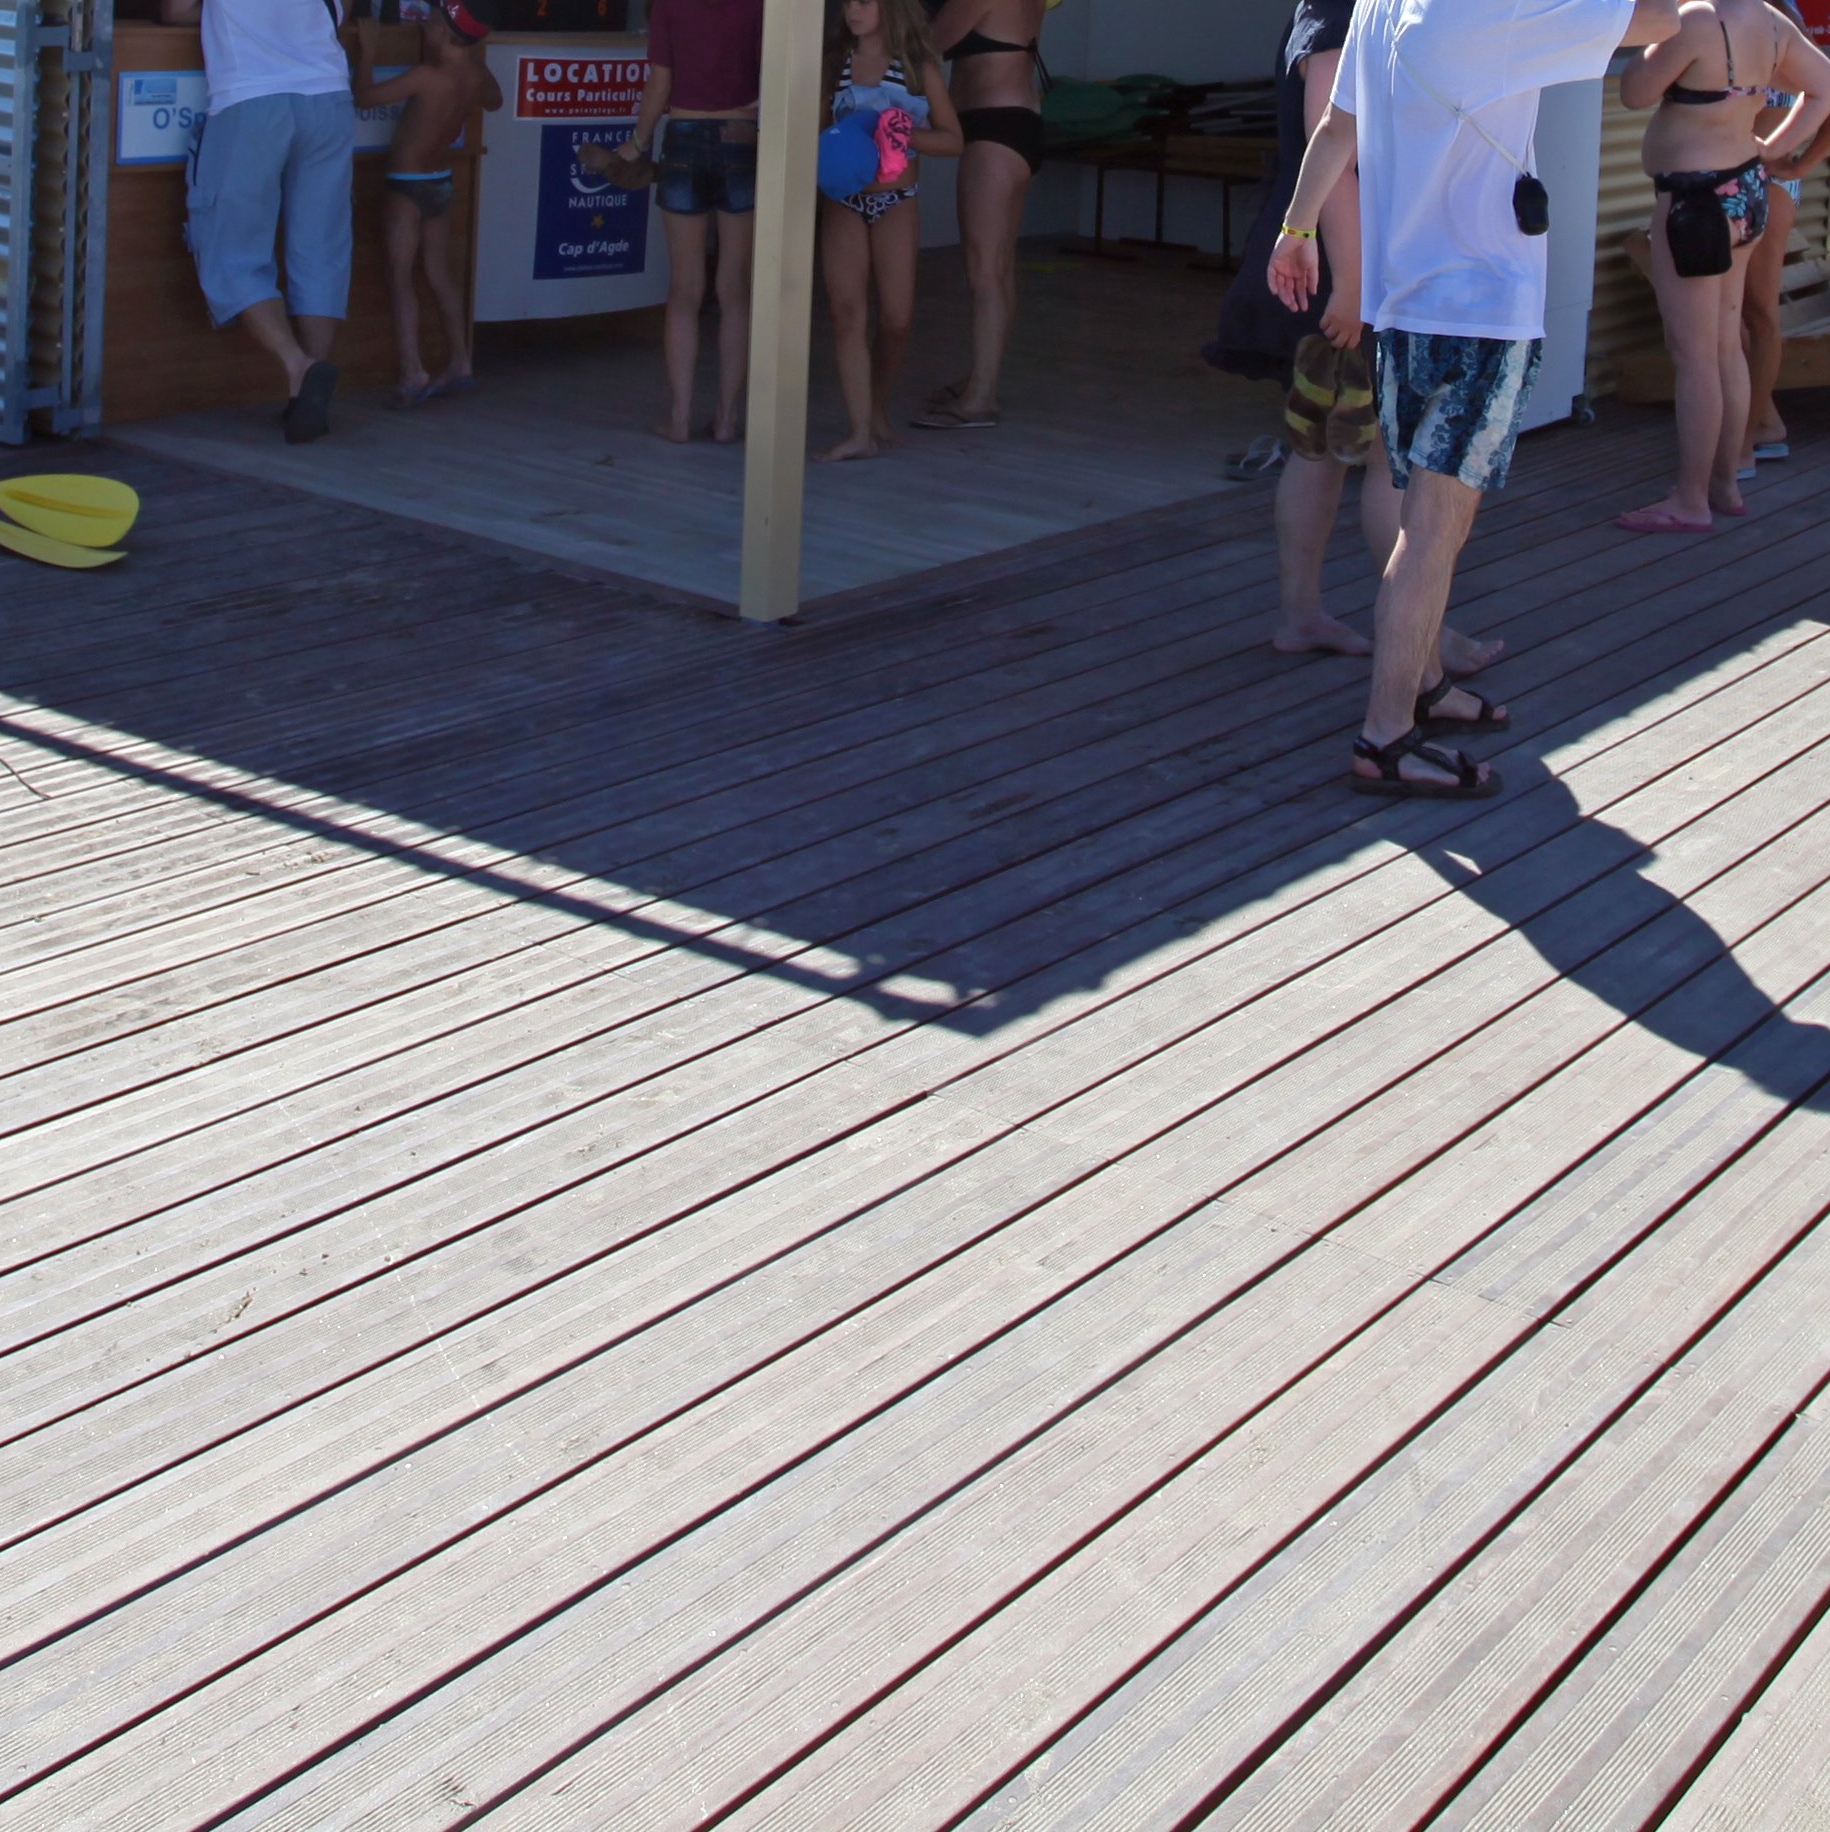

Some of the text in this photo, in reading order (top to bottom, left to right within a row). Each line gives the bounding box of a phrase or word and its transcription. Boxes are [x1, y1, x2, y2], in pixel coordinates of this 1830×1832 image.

[525, 87, 644, 102] Cours Particulie
[571, 129, 633, 143] FRANCE
[568, 194, 628, 208] NAUTIQUE
[558, 240, 630, 258] Cap d'Agde
